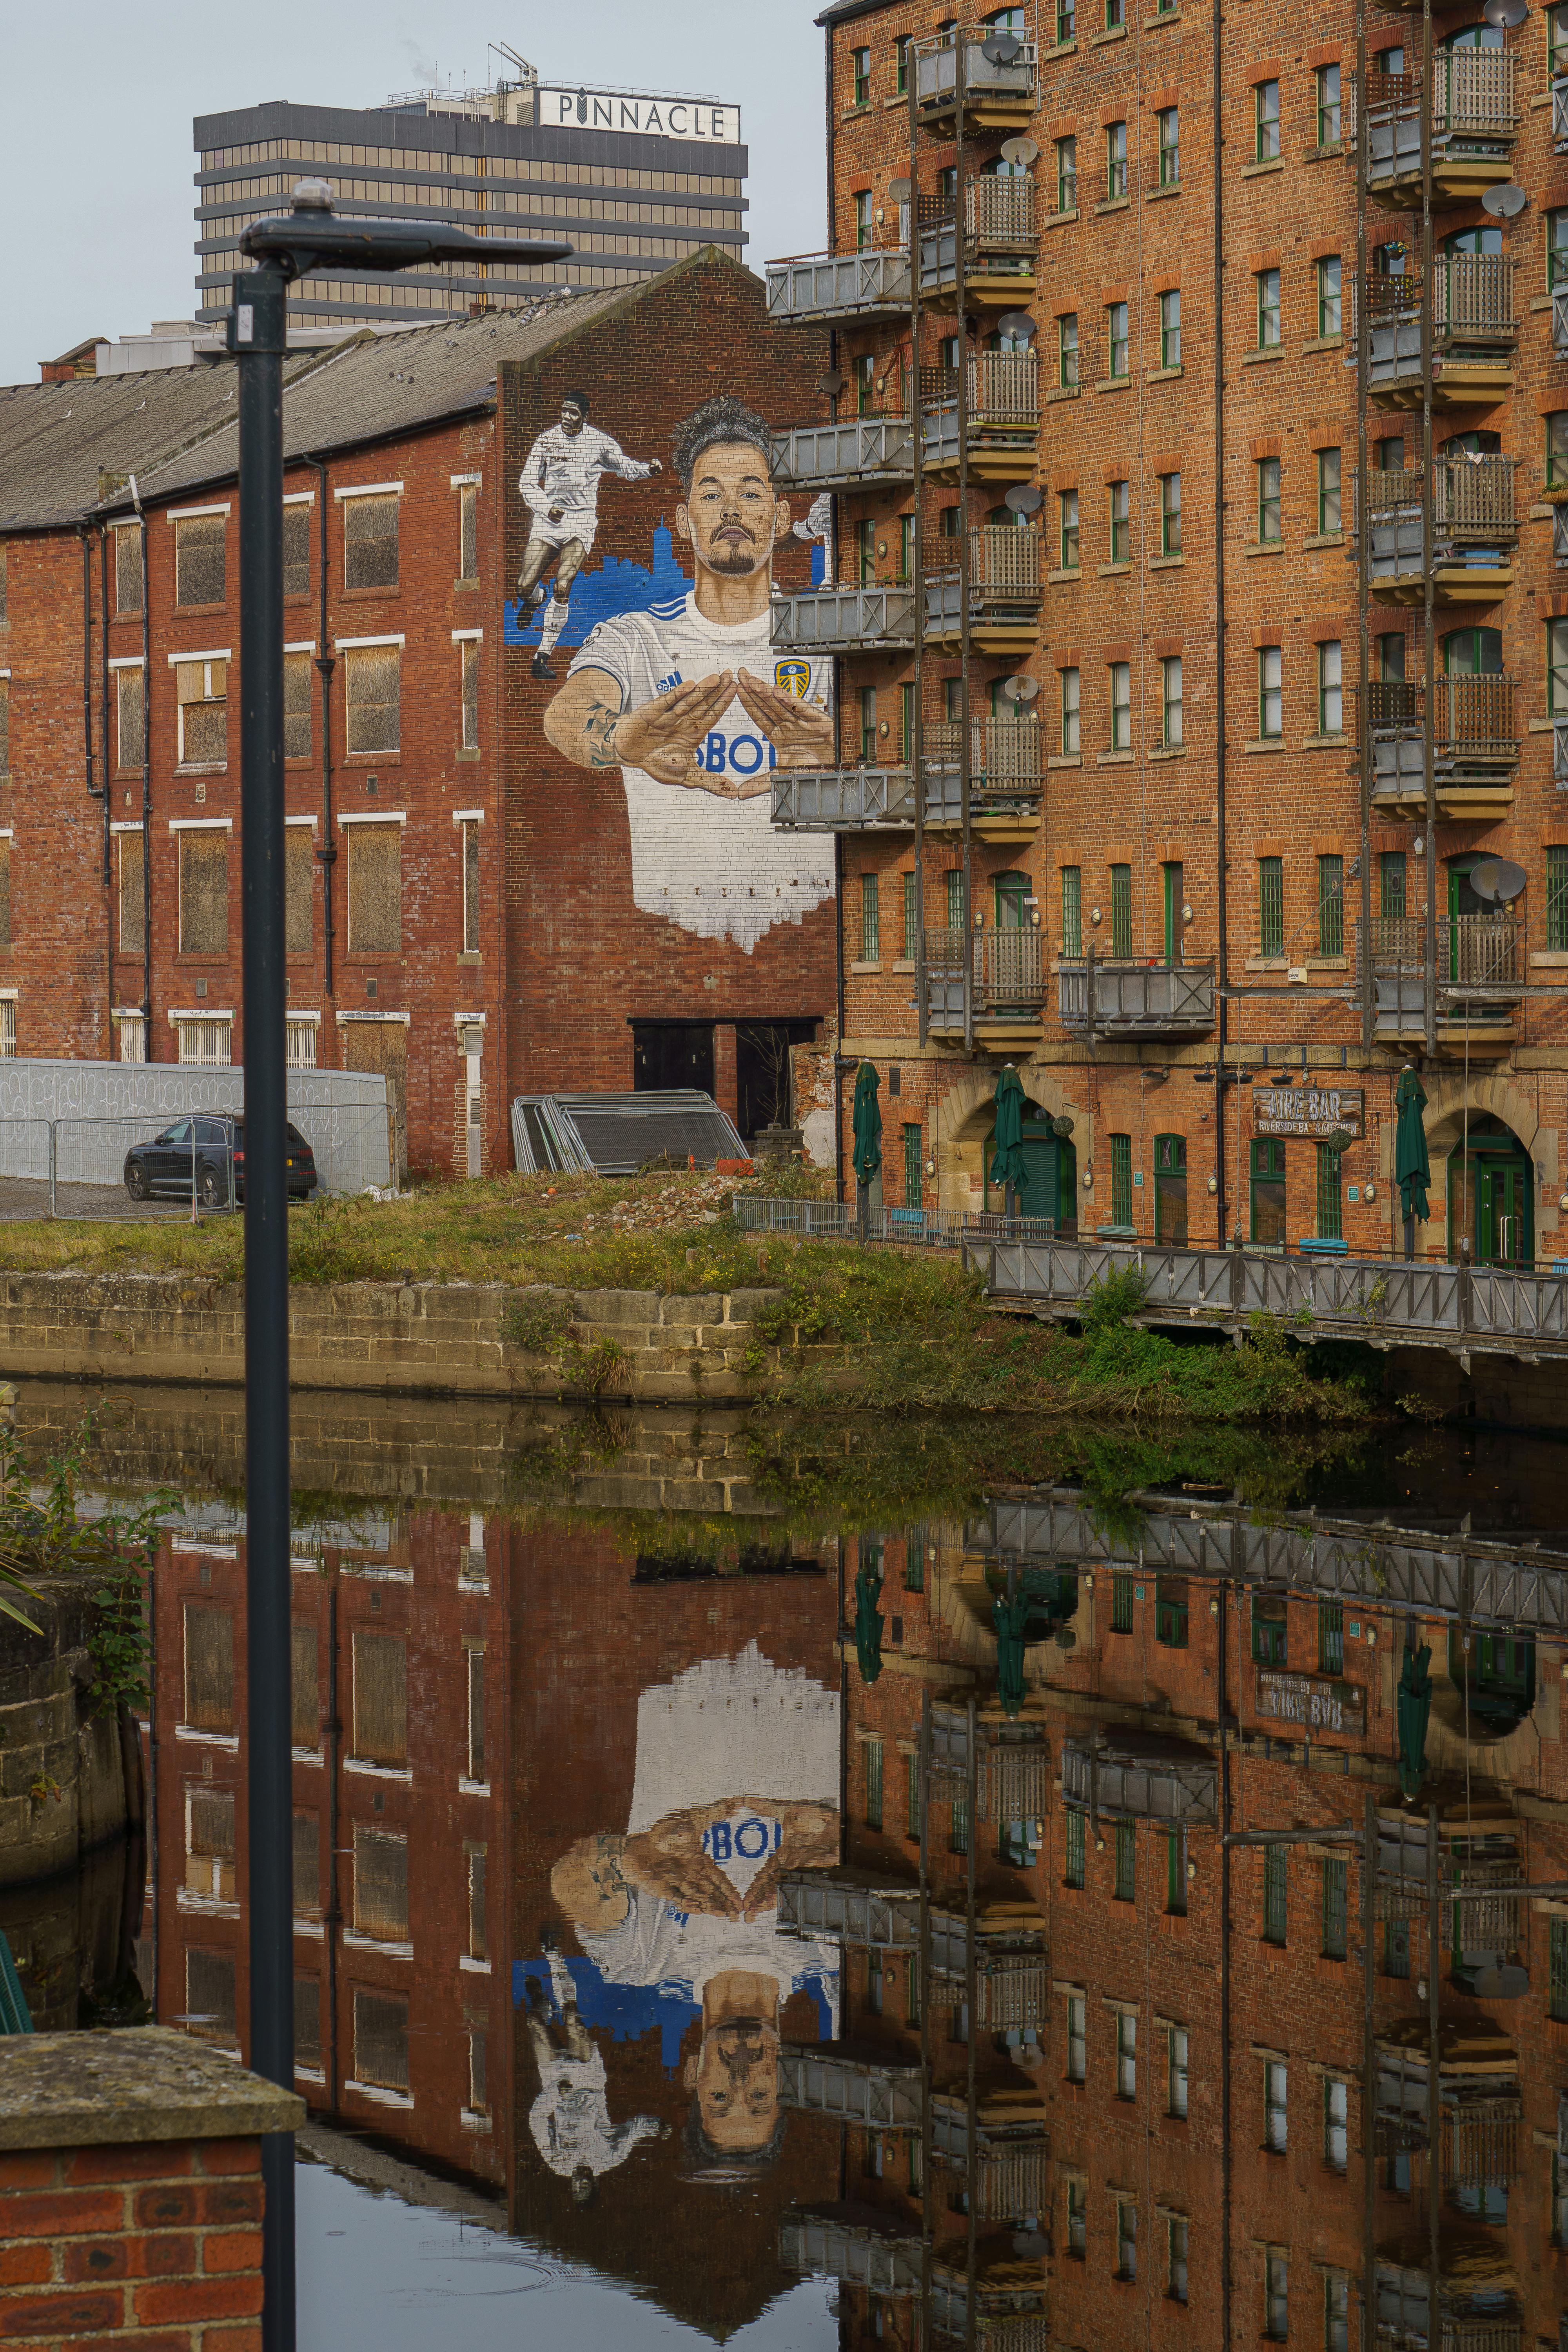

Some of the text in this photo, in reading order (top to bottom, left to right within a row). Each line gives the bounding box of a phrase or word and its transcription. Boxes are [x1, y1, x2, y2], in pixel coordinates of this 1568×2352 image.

[560, 87, 724, 136] PINNACLE
[1269, 1090, 1342, 1121] AIRE BAR
[1259, 1120, 1298, 1132] RIVERSIDE
